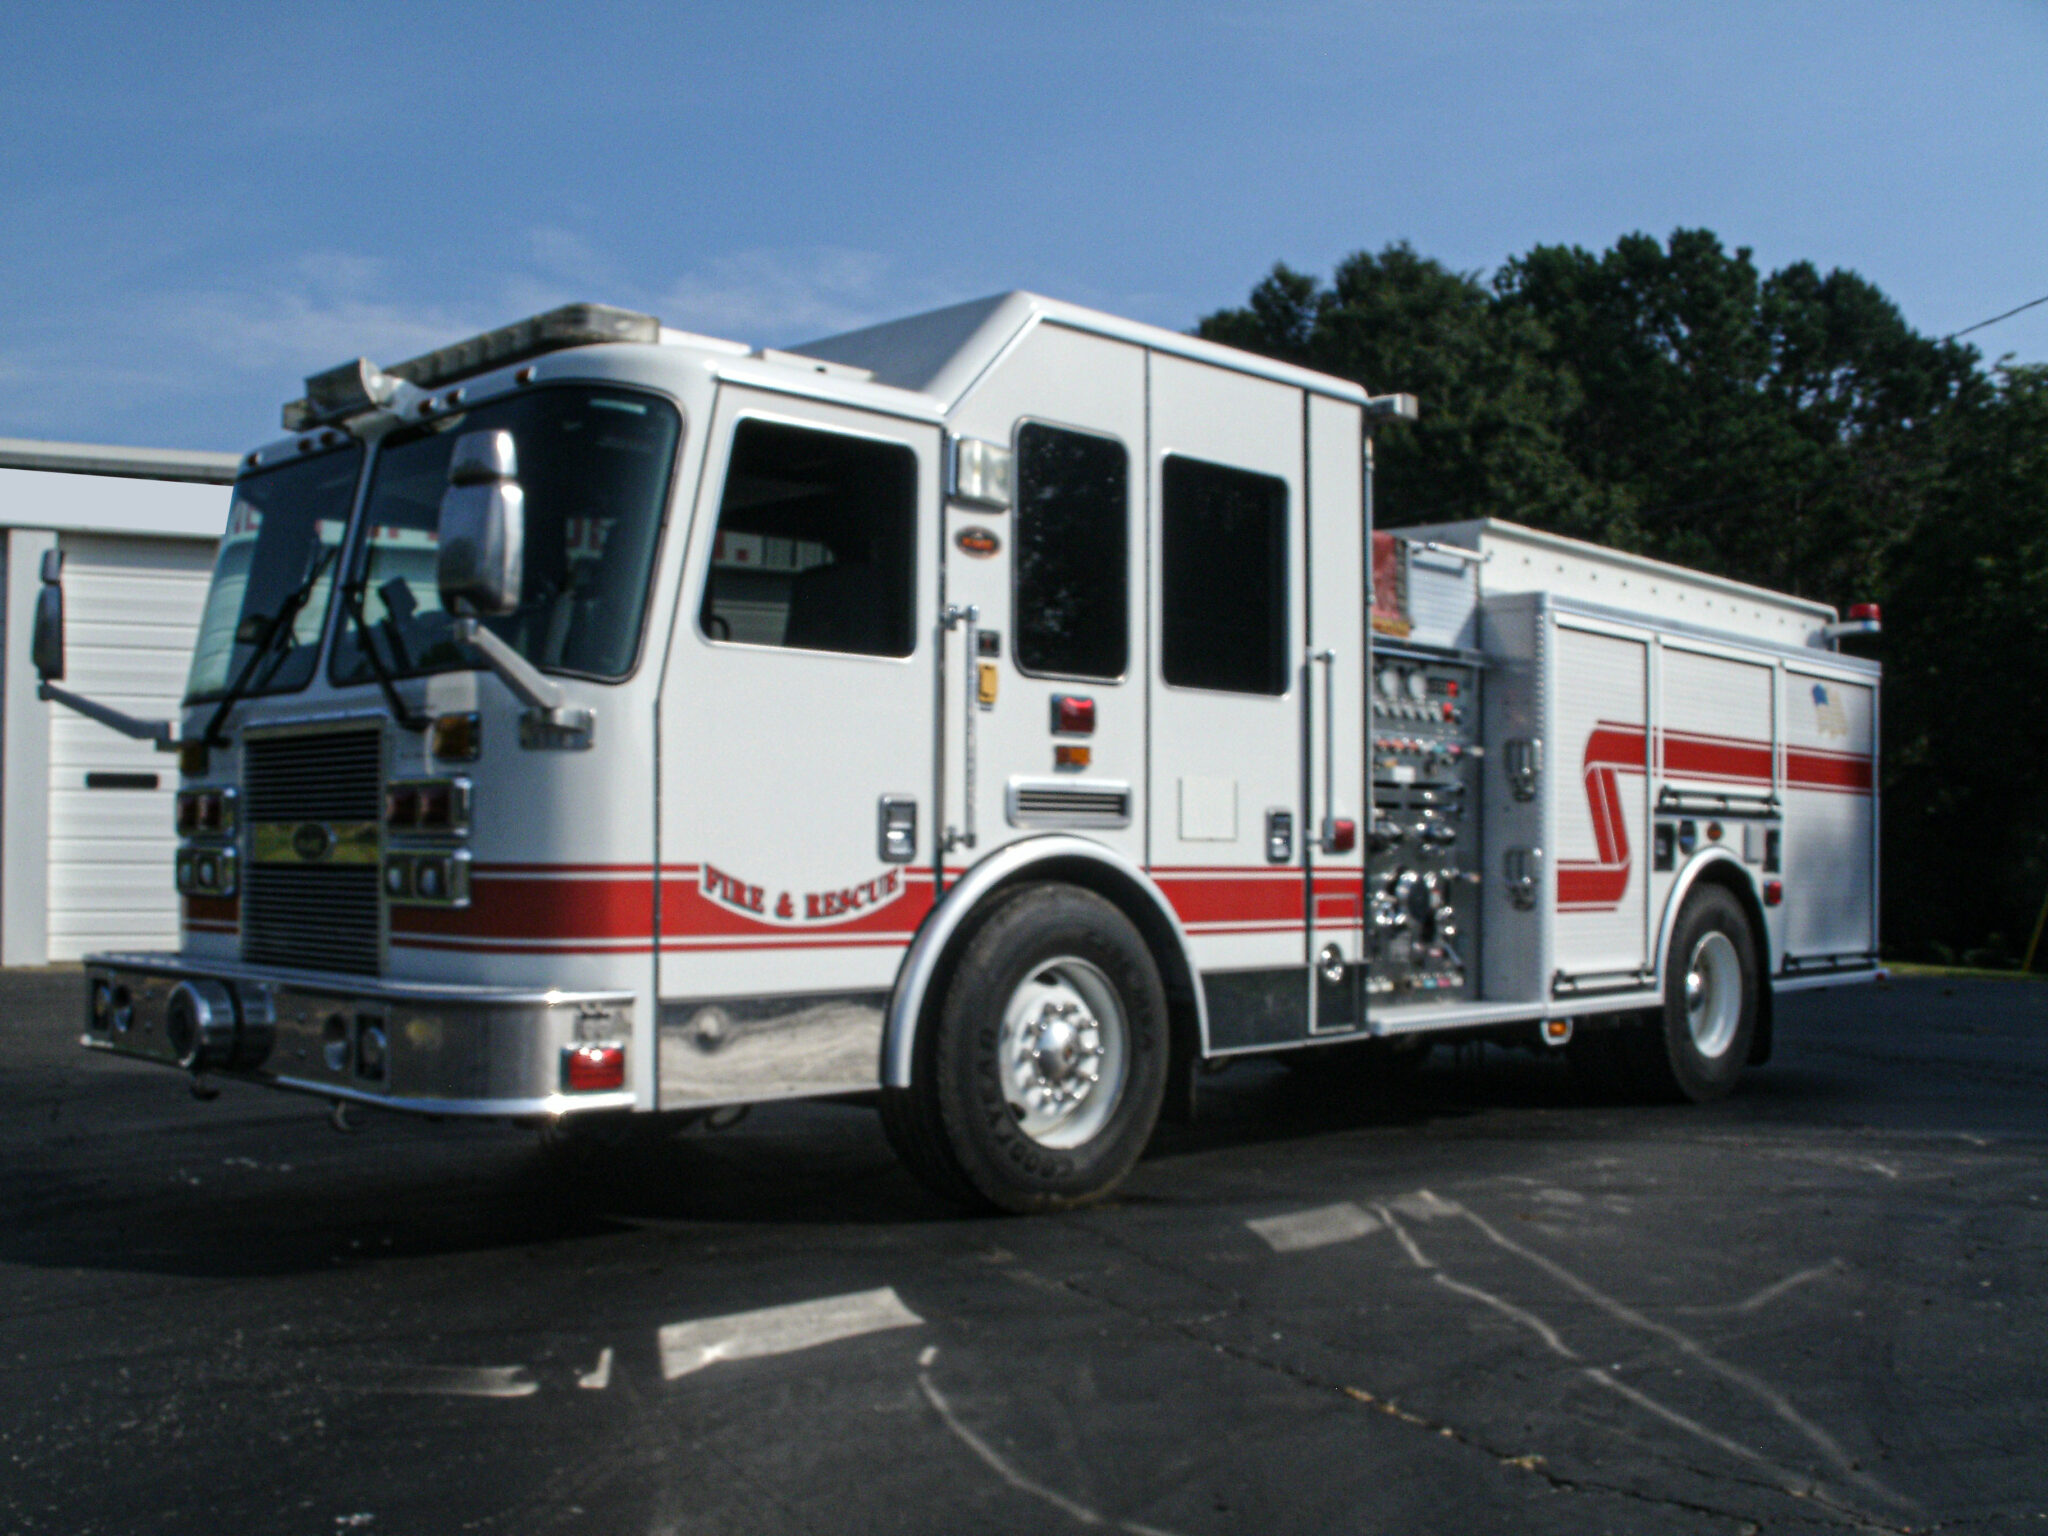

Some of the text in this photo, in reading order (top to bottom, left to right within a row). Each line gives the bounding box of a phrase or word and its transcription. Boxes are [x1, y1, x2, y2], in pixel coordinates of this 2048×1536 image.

[702, 863, 899, 920] FIRE & RESCUE
